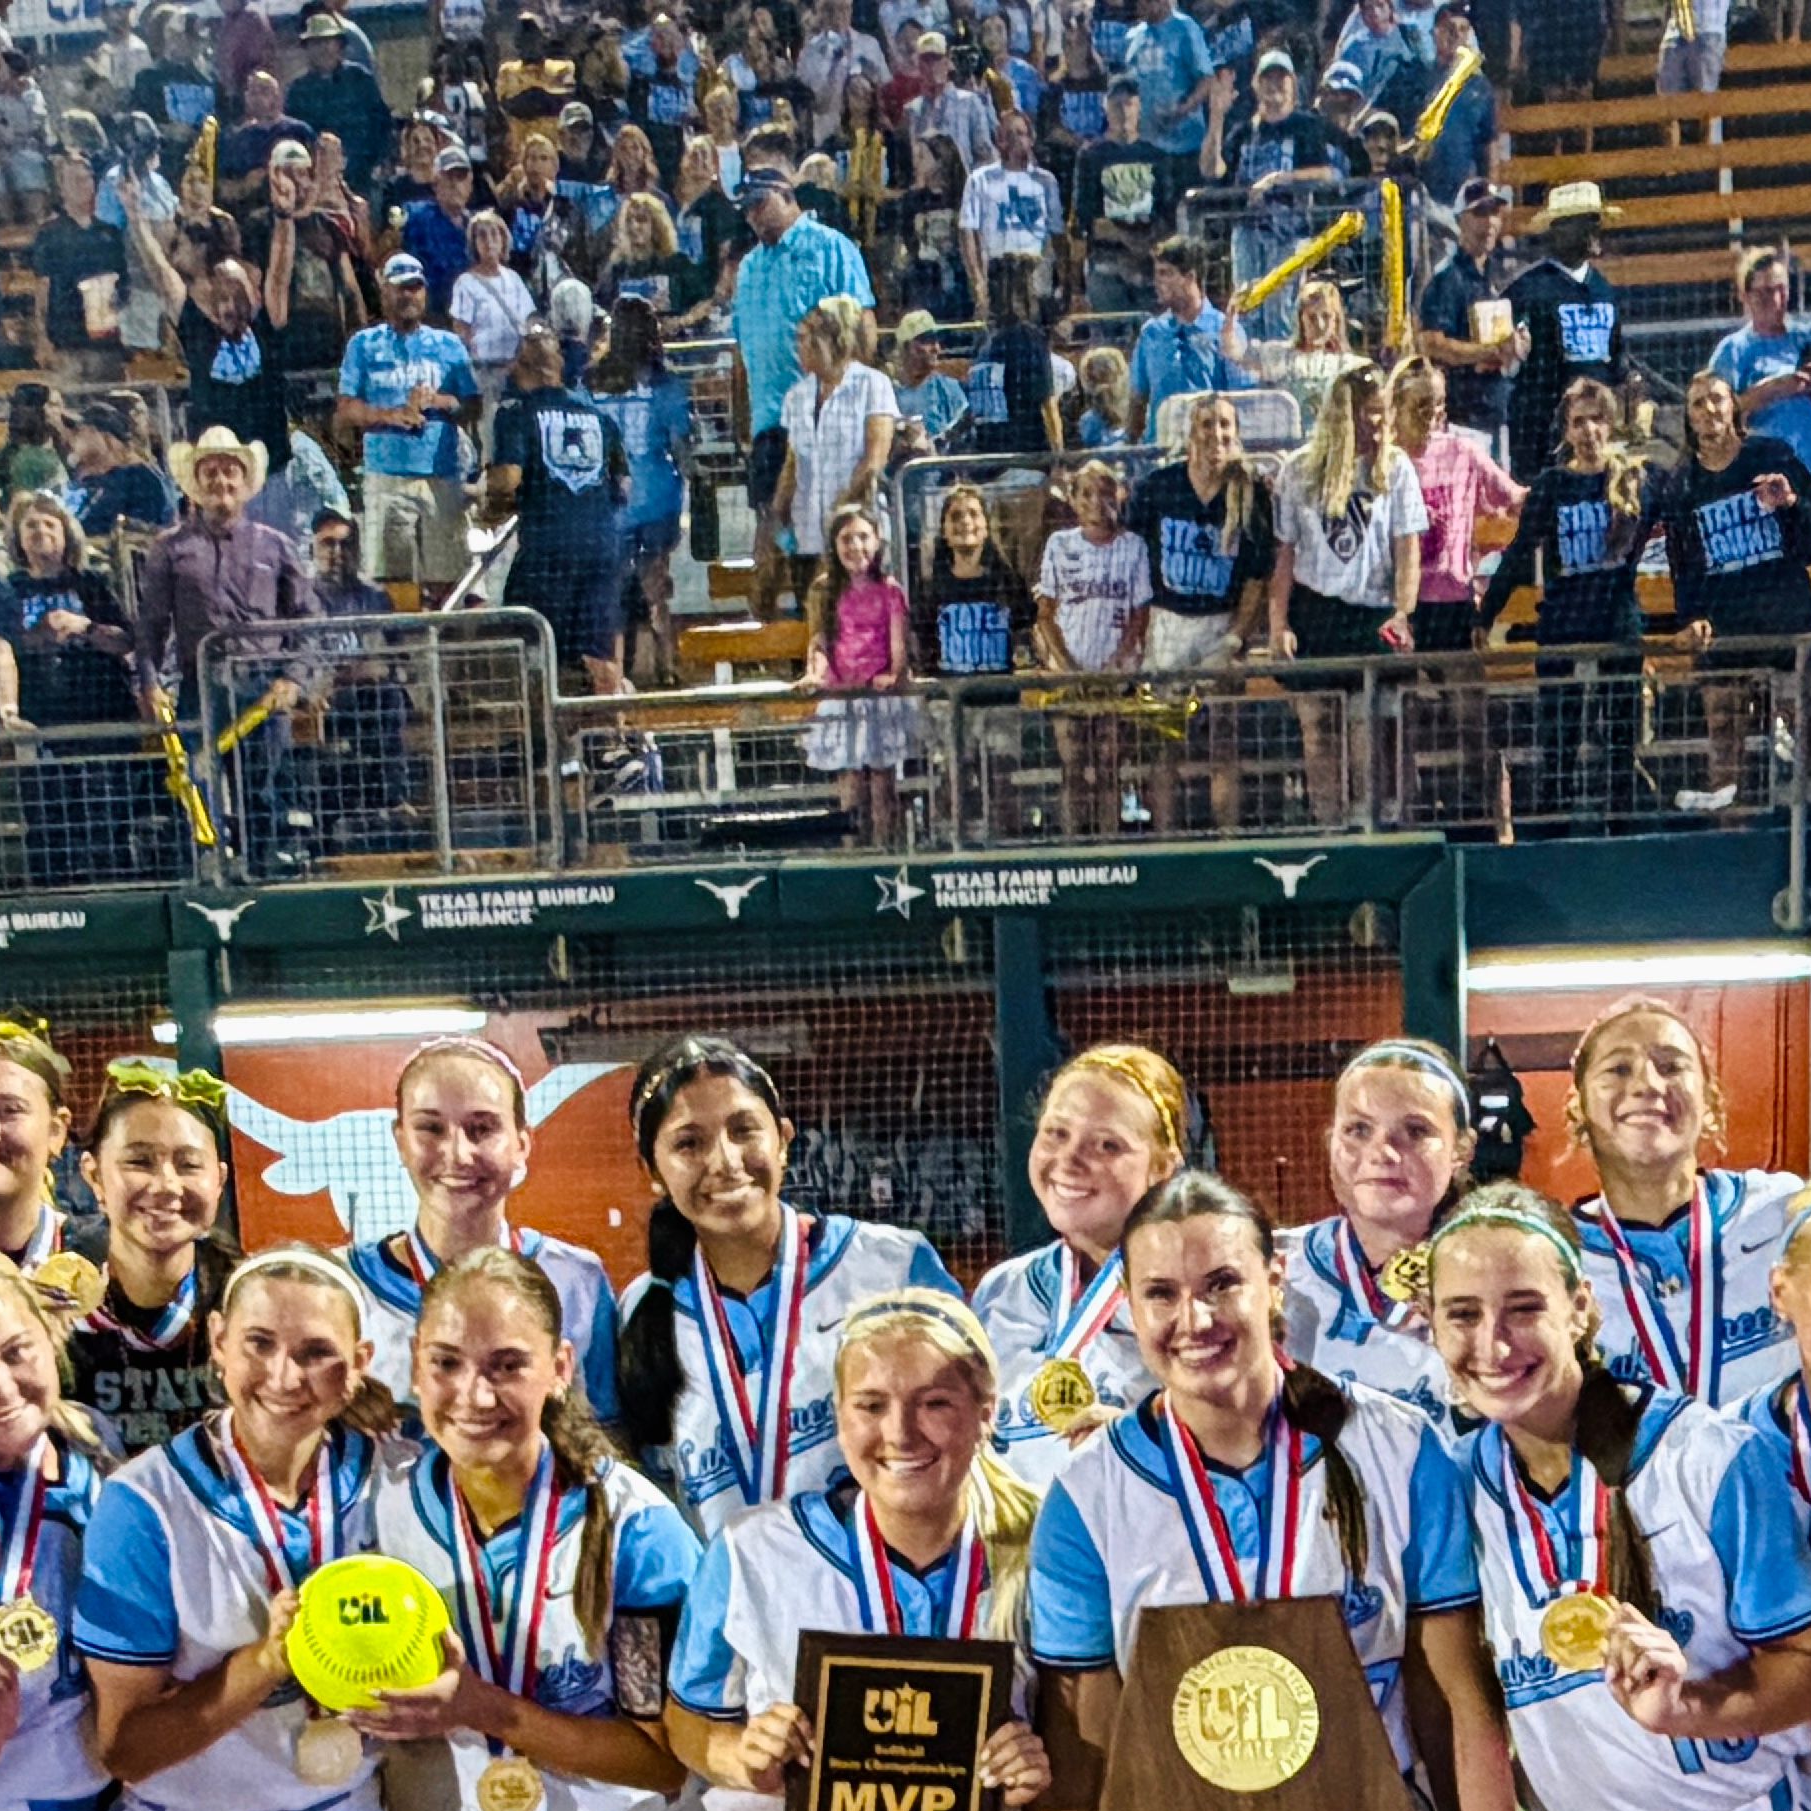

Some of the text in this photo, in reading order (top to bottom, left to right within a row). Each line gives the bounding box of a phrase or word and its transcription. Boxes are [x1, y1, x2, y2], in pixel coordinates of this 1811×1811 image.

[931, 865, 1138, 890] TEXAS FARM BUREAU
[417, 886, 616, 912] TEXAS FARM BUREAU
[935, 887, 1051, 908] INSURANCE
[12, 911, 87, 931] BUREAU
[422, 908, 534, 929] INSURANCE
[94, 1363, 225, 1412] STAT
